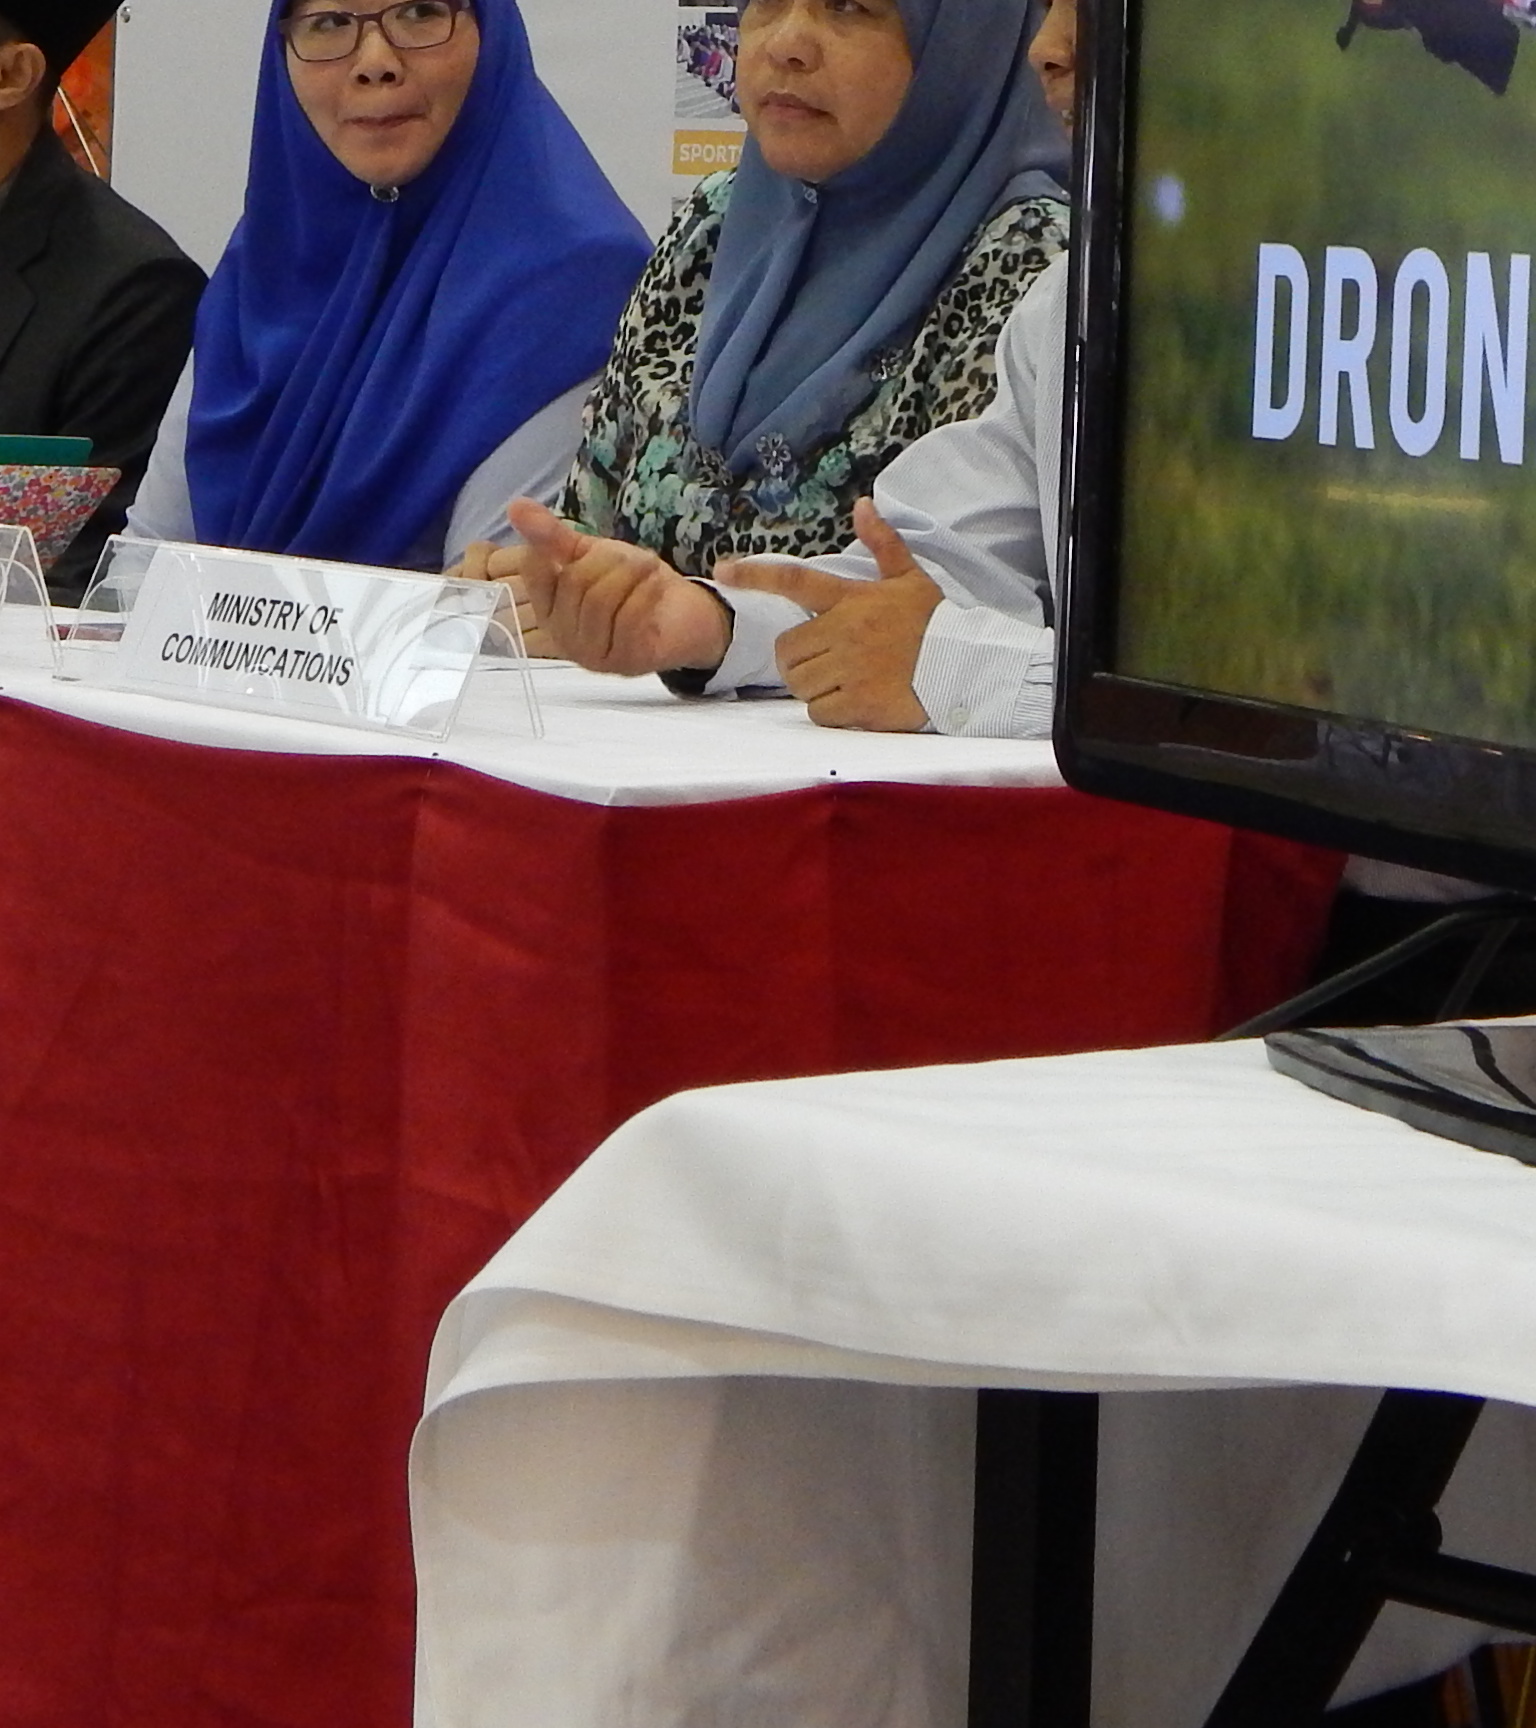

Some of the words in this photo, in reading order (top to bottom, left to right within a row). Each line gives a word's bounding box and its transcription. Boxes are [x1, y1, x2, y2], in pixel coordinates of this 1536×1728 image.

[679, 143, 742, 164] SPORT
[205, 592, 309, 631] MINISTRY
[308, 605, 344, 635] OF
[161, 632, 354, 686] COMMUNICATIONS
